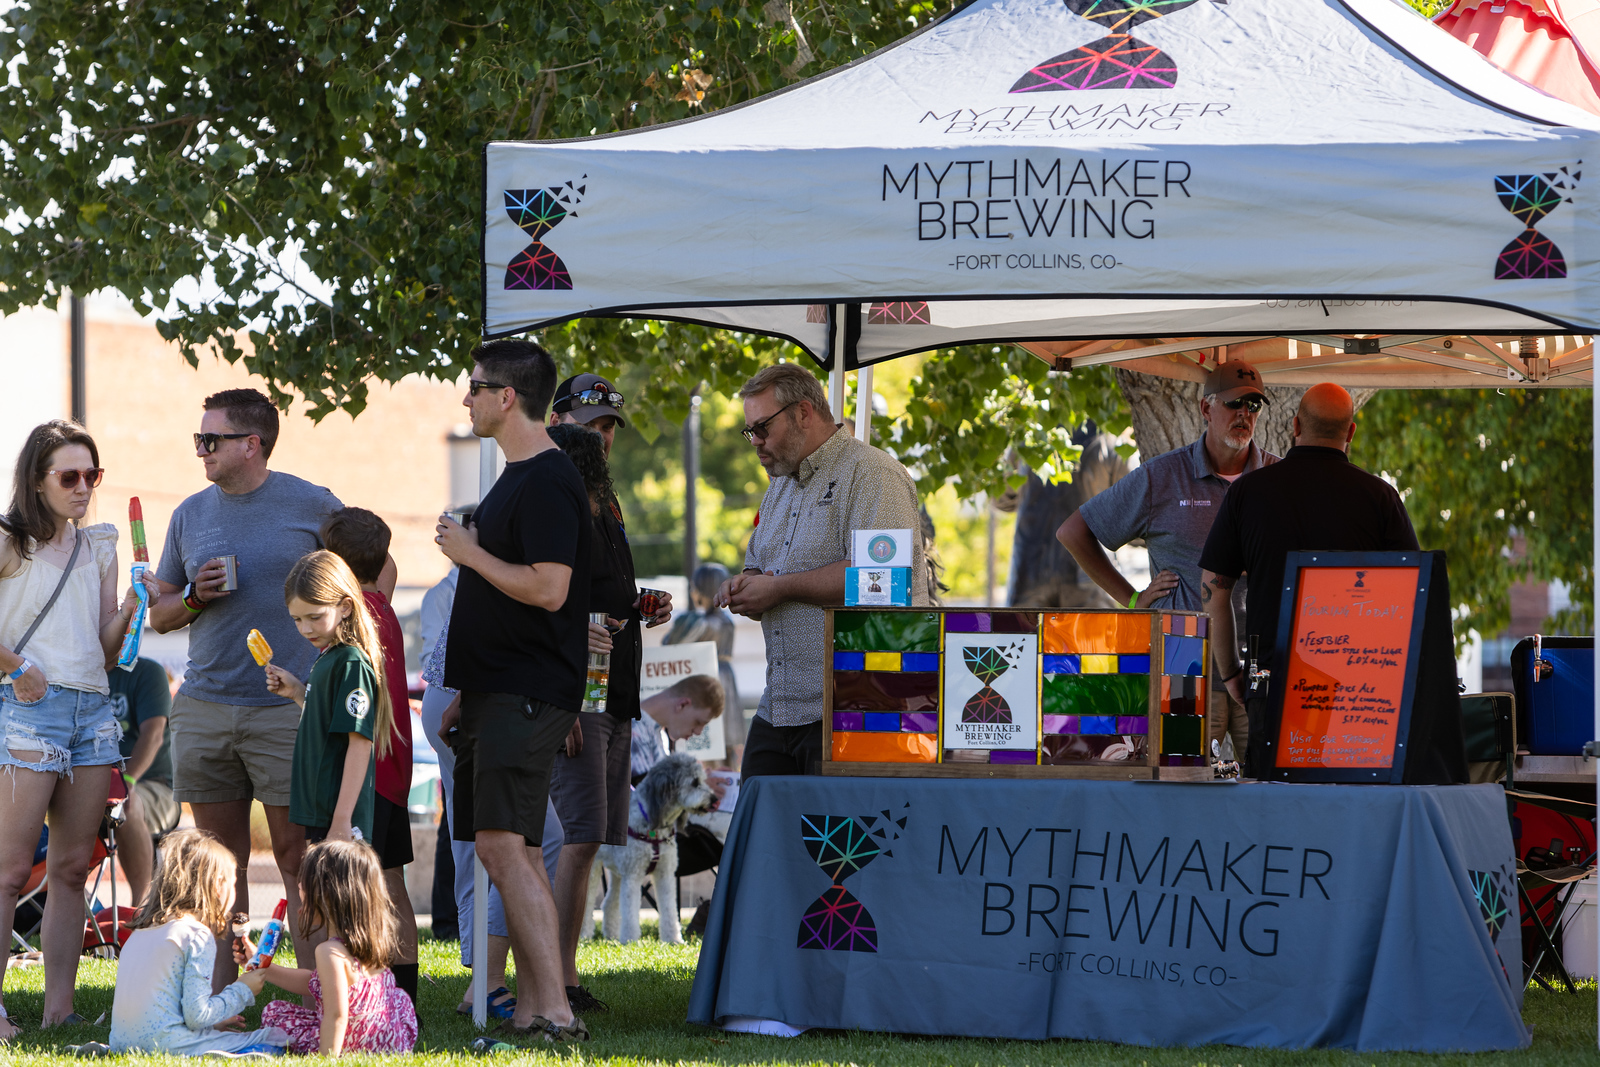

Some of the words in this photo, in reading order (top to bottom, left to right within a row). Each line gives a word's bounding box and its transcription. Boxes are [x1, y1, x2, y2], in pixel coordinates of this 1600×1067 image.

[919, 103, 1231, 123] MYTHMAKER
[944, 117, 1184, 133] BREWING
[882, 158, 1191, 200] MYTHMAKER
[918, 198, 1155, 240] BREWING
[949, 254, 1001, 270] -FORT
[1006, 253, 1085, 270] COLLINS,
[1090, 254, 1123, 269] CO-
[1303, 596, 1350, 617] POURING
[1381, 646, 1402, 655] LAGER
[645, 659, 692, 678] EVENTS
[1333, 682, 1356, 693] SPICE
[1358, 683, 1376, 693] ALE
[955, 724, 1021, 732] MYTHMAKER
[964, 732, 1012, 740] BREWING
[1290, 730, 1313, 744] VISIT
[1319, 734, 1337, 744] OUR
[937, 824, 1333, 900] MYTHMAKER
[980, 882, 1280, 957] BREWING
[1017, 951, 1077, 973] -FORT
[1080, 953, 1186, 988] COLLINS,
[1193, 965, 1238, 987] CO-
